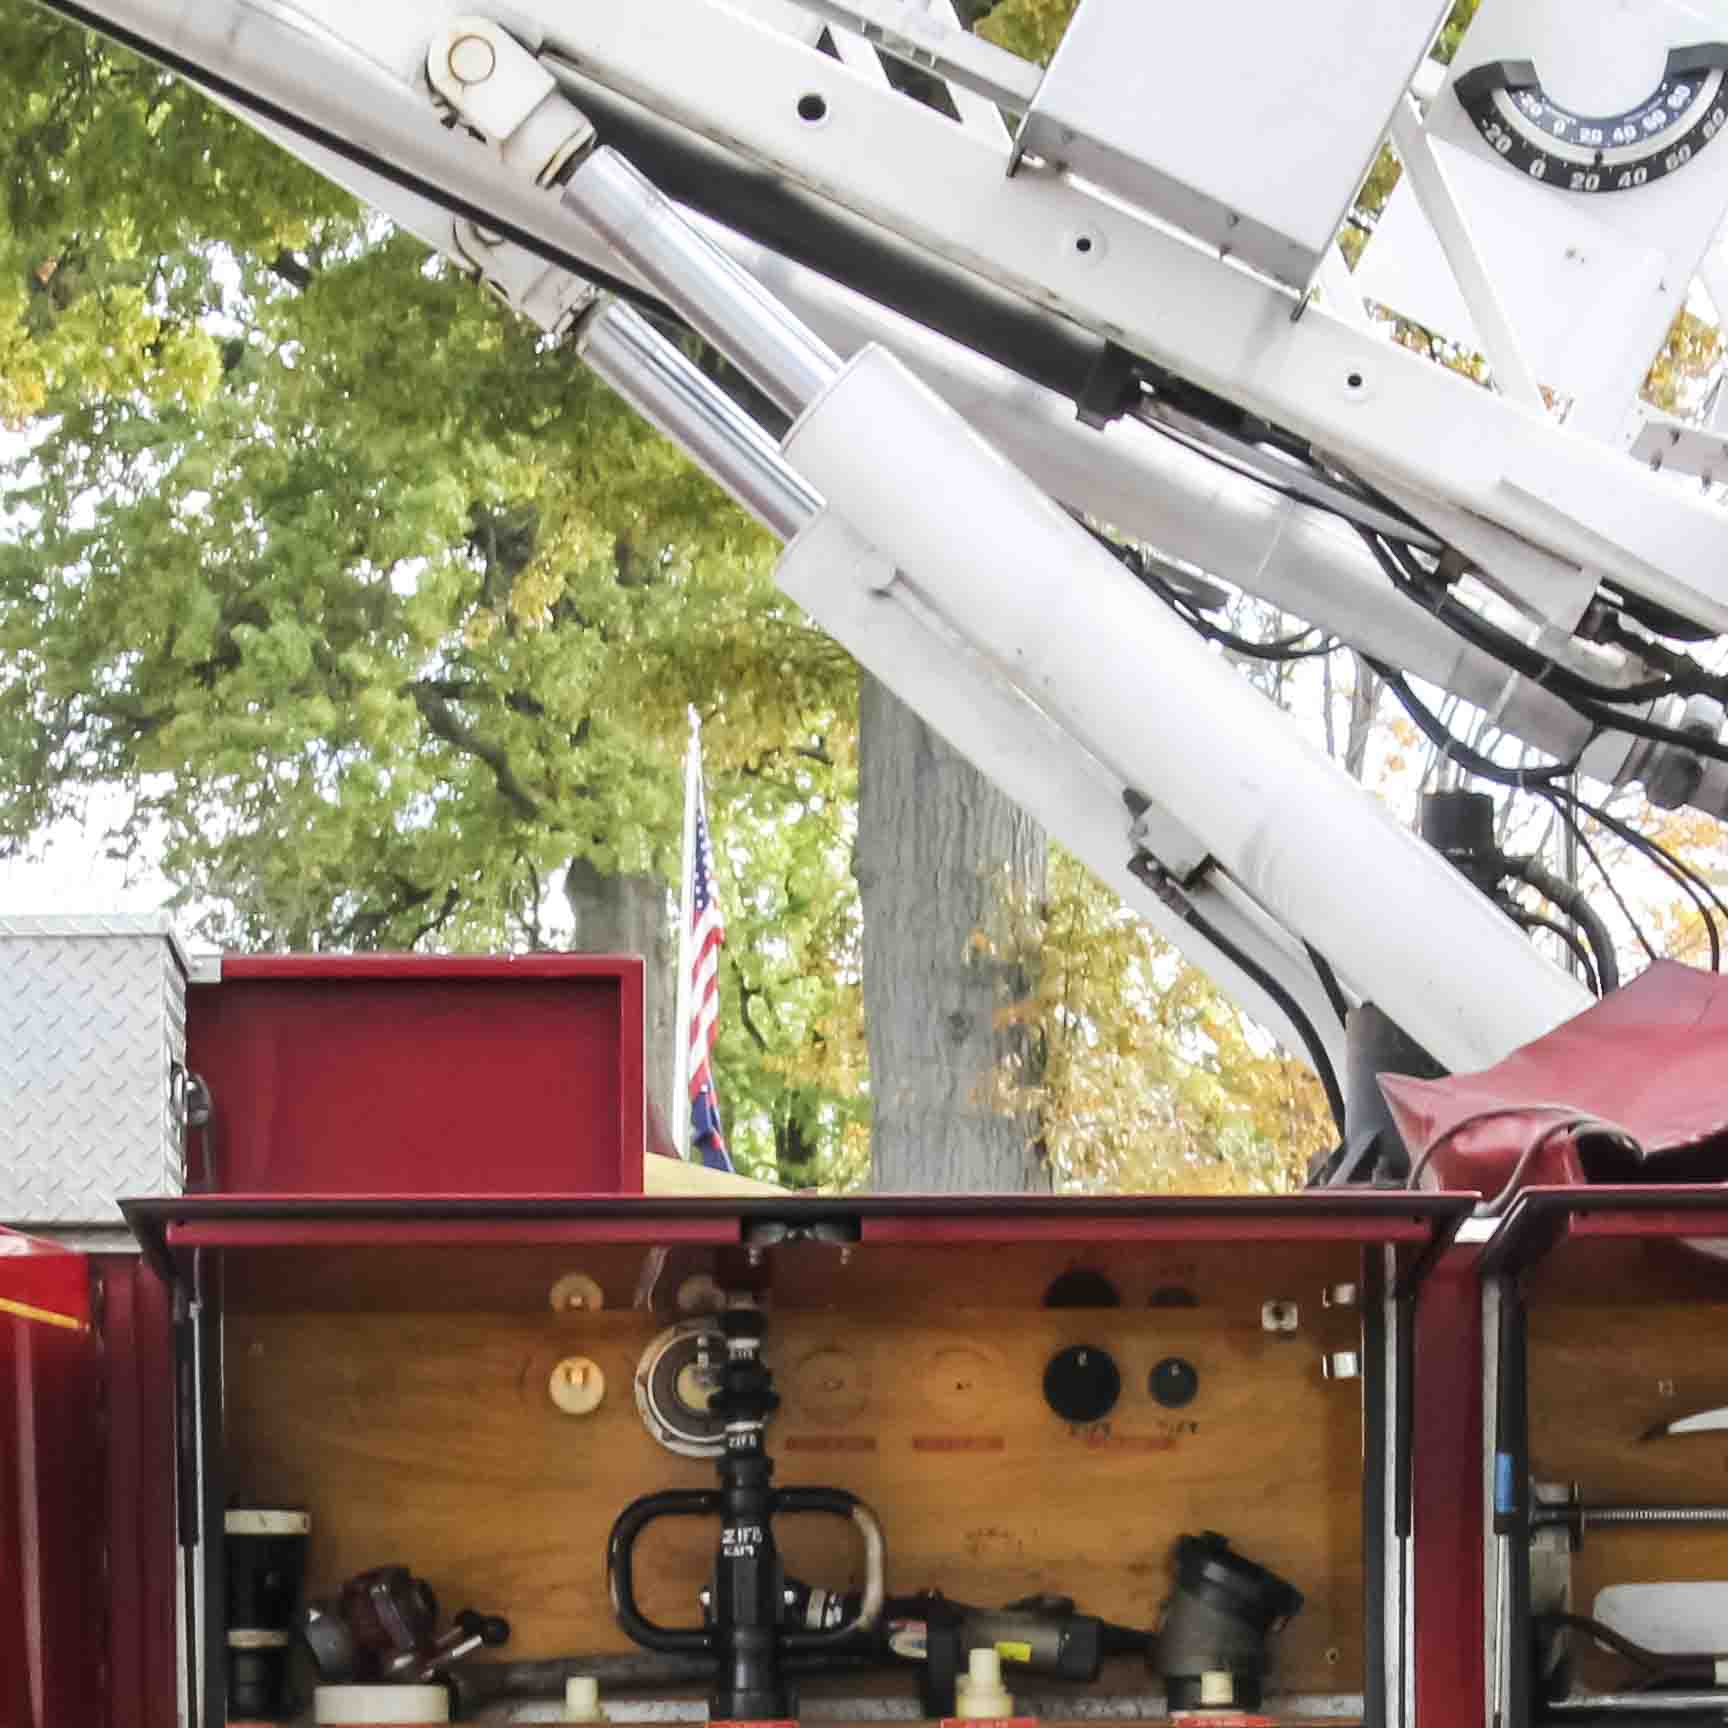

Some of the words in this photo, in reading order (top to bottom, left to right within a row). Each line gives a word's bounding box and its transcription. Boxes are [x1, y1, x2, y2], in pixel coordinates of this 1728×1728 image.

[1579, 127, 1603, 144] 20
[1613, 124, 1637, 143] 40
[1529, 158, 1546, 179] 0
[1569, 171, 1600, 192] 20
[1617, 166, 1648, 188] 40
